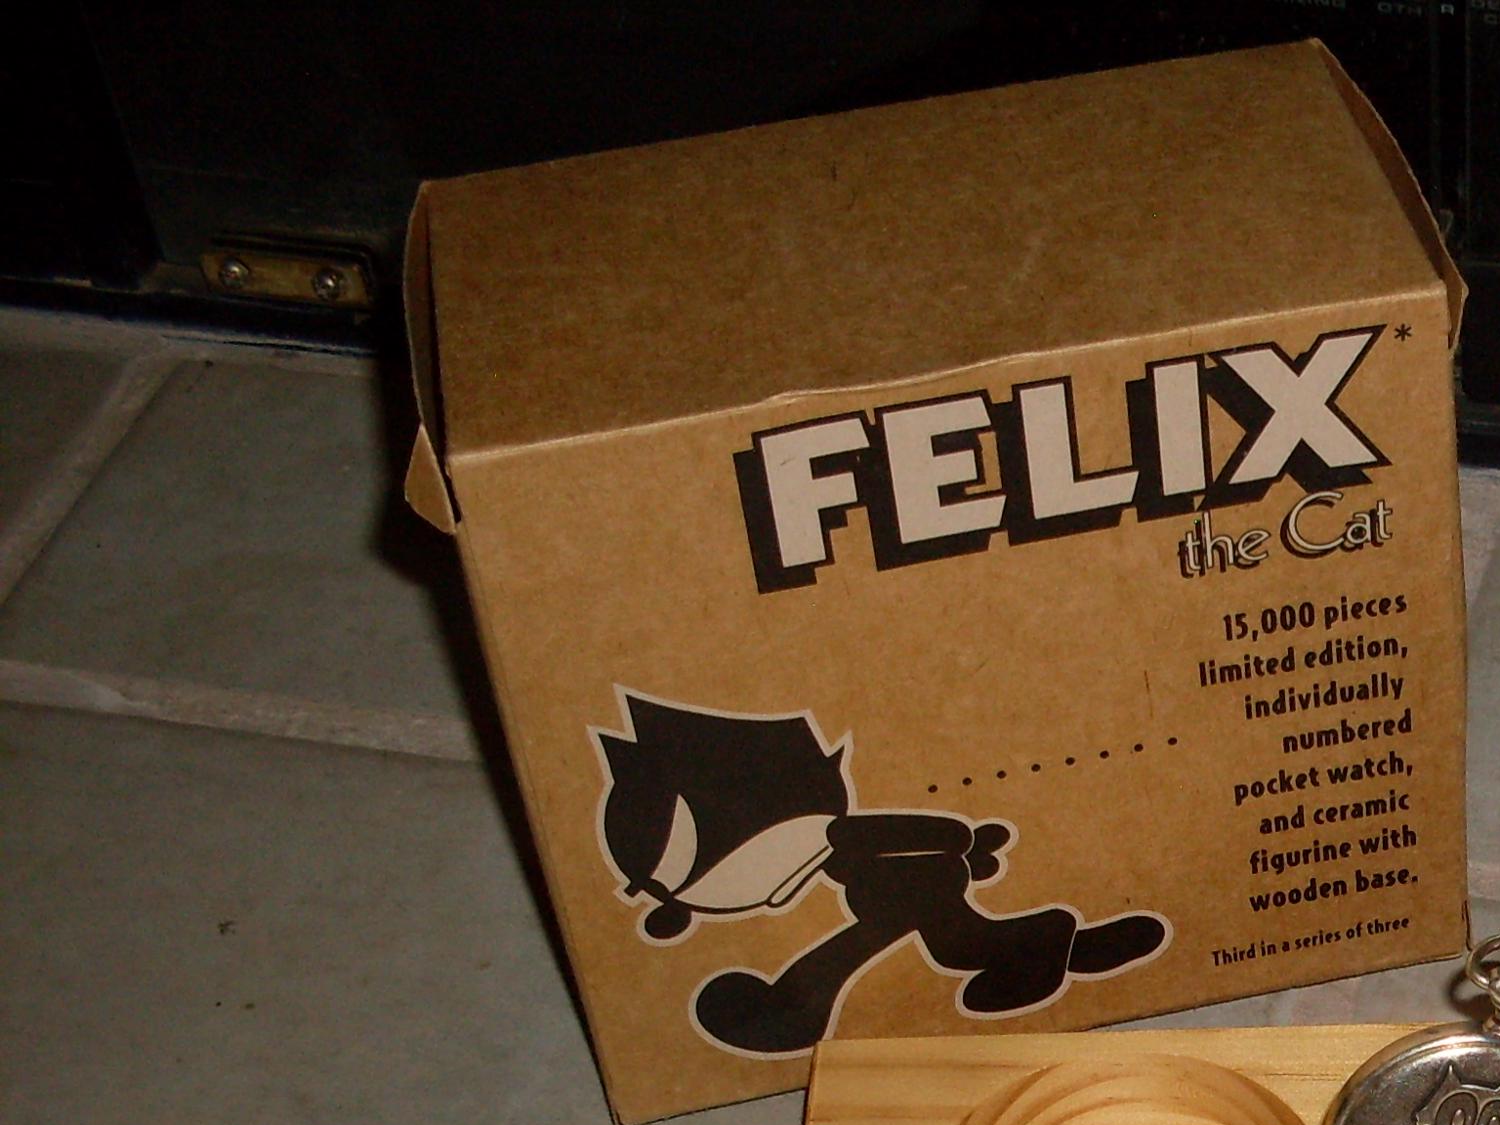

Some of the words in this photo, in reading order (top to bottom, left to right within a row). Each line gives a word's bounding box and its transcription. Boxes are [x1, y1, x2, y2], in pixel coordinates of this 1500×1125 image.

[733, 324, 1393, 594] FELIX
[1177, 511, 1271, 578] the
[1280, 490, 1393, 558] Cat
[1223, 602, 1315, 641] 15,000
[1324, 594, 1407, 630] pieces
[1199, 646, 1296, 688] limited
[1304, 634, 1408, 668] edition,
[1244, 671, 1405, 720] individually
[1282, 708, 1412, 753] numbered
[1234, 765, 1320, 806] pocket
[1327, 751, 1413, 785] watch,
[1259, 804, 1305, 835] and
[1313, 789, 1411, 826] ceramic
[1249, 839, 1352, 875] figurine
[1358, 825, 1417, 855] with
[1249, 876, 1348, 912] wooden
[1356, 867, 1419, 893] base.
[1212, 946, 1256, 967] Third
[1260, 939, 1277, 957] in
[1281, 939, 1290, 952] a
[1294, 928, 1342, 950] series
[1345, 919, 1364, 940] of
[1366, 916, 1410, 936] three
